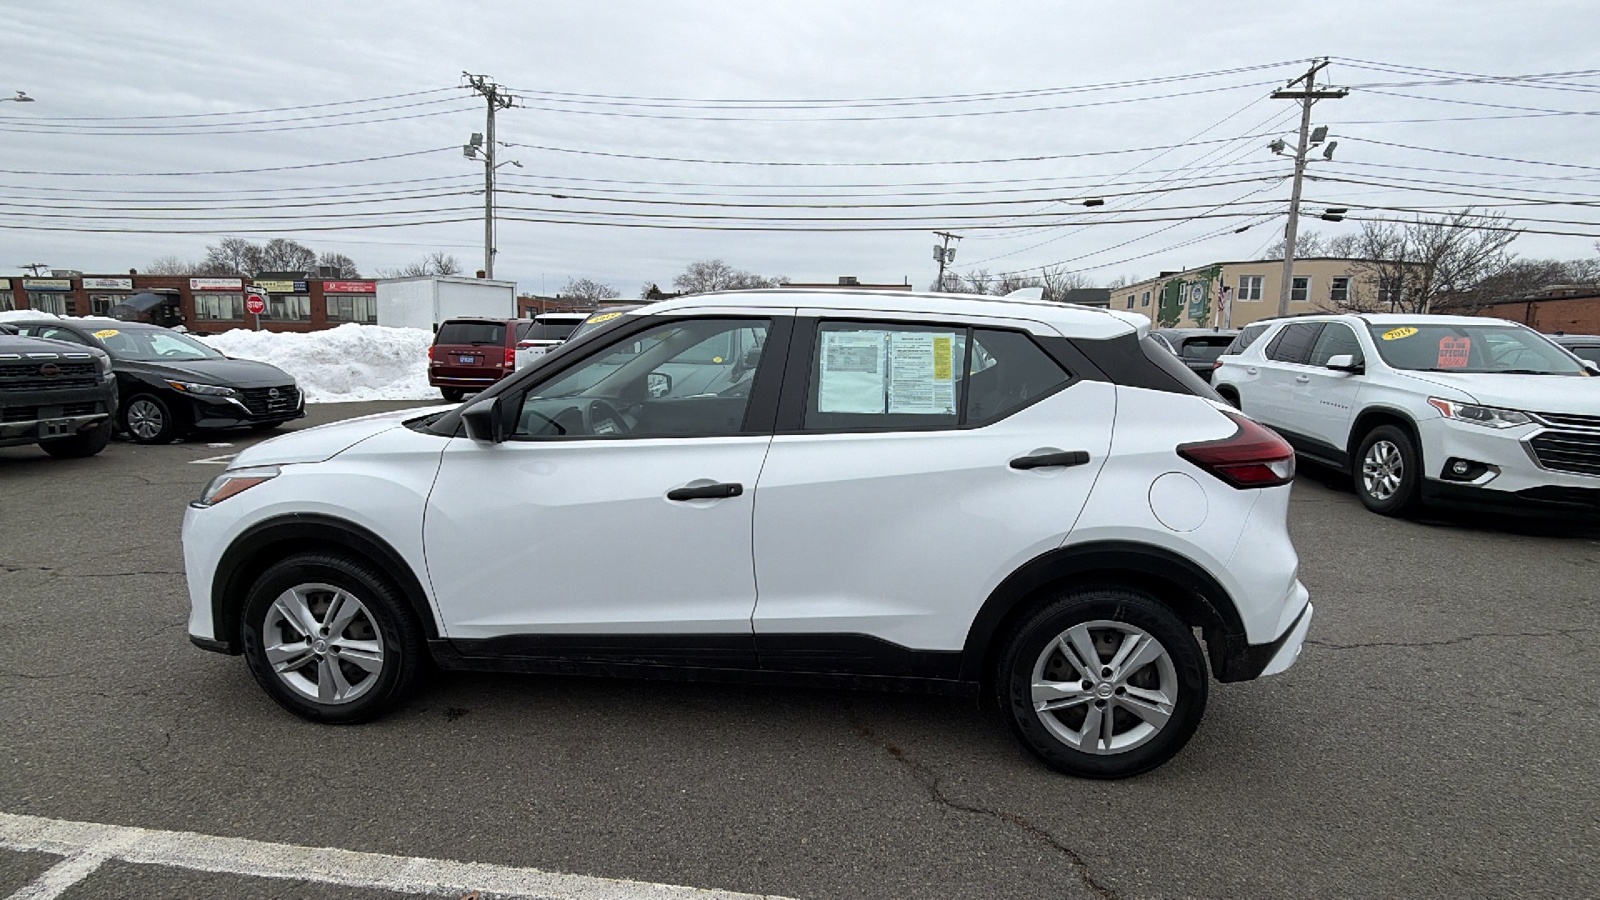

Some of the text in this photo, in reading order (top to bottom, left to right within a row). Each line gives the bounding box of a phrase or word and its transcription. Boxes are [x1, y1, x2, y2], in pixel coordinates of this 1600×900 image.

[248, 301, 263, 309] STOP
[1388, 327, 1411, 339] 2019
[1440, 349, 1467, 357] SPECIAL
